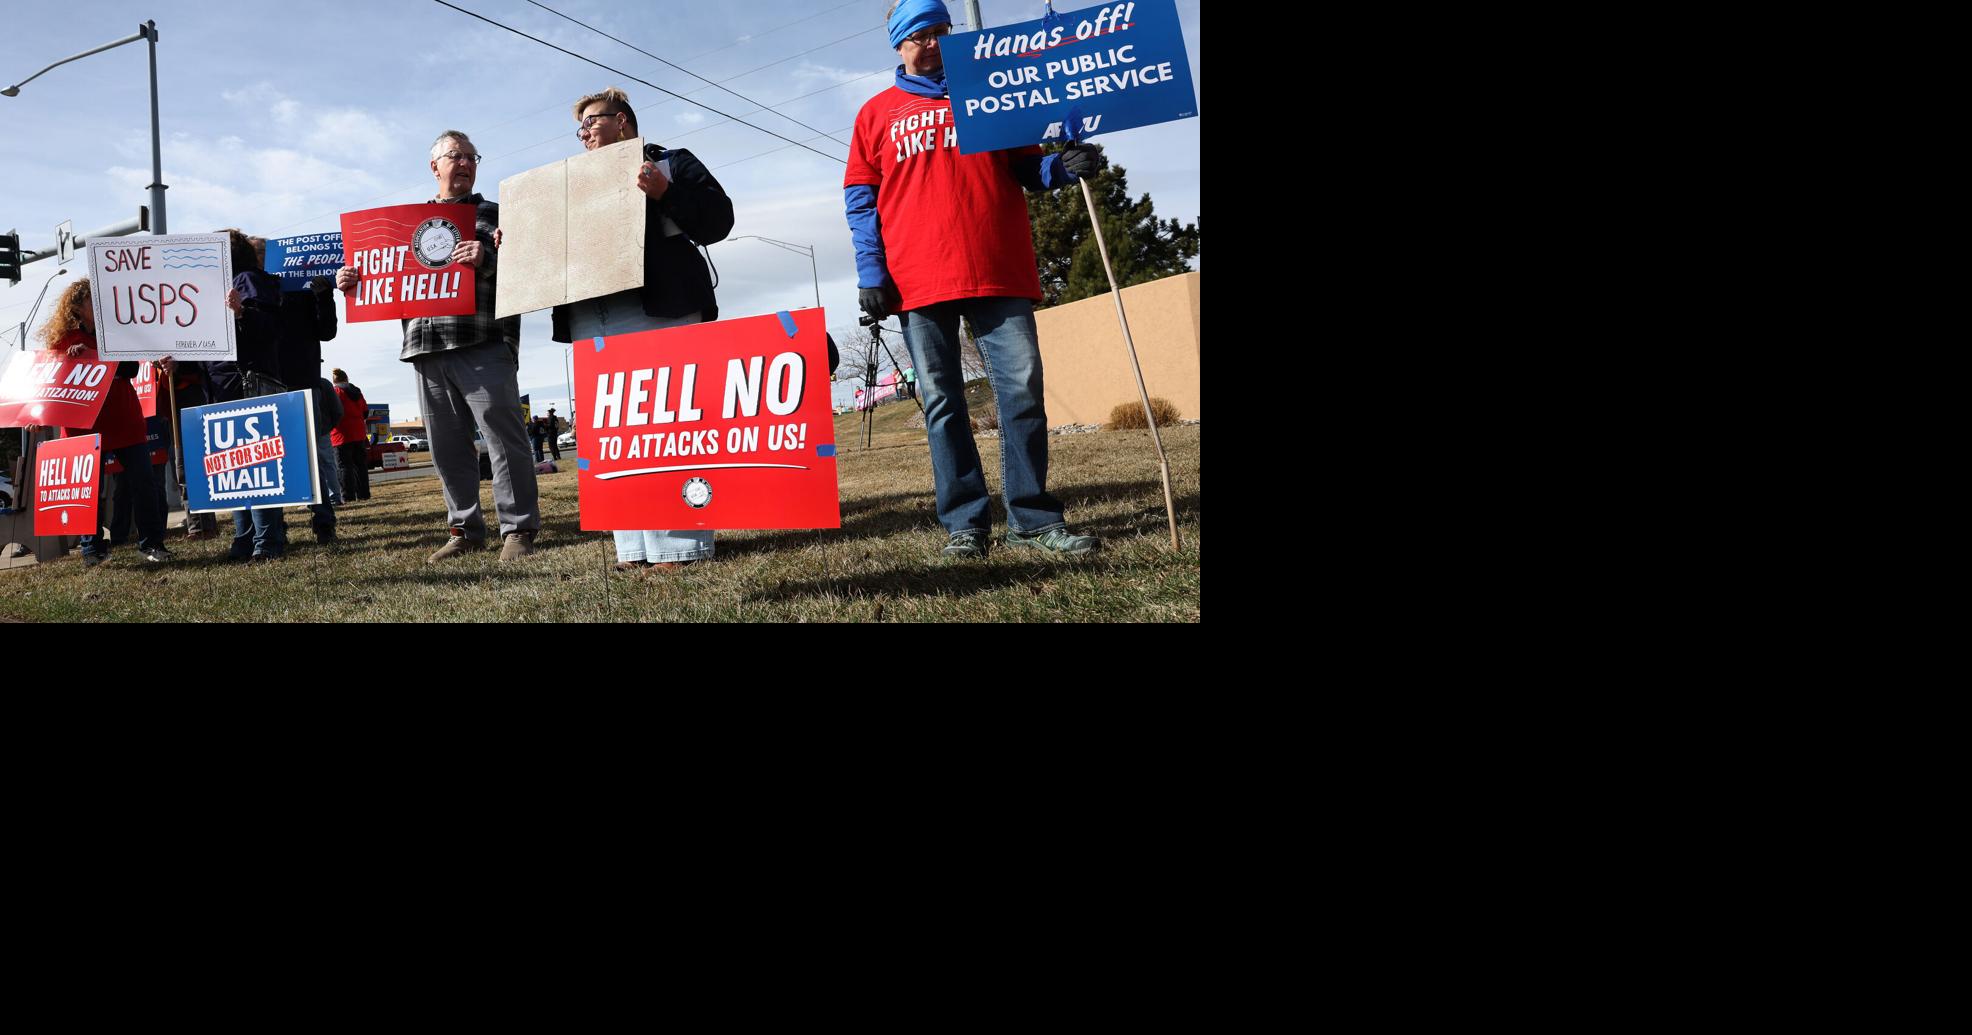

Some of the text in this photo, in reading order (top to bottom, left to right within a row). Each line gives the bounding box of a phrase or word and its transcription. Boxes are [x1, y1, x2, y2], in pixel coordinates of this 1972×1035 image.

[1075, 2, 1135, 41] off!
[988, 45, 1136, 89] OUR PUBLIC
[965, 62, 1173, 116] POSTAL SERVICE
[891, 108, 949, 142] FIGHT
[896, 128, 936, 163] LIKE
[286, 243, 330, 254] BELONGS
[296, 235, 321, 244] POST
[105, 246, 152, 273] SAVE
[283, 256, 304, 267] THE
[288, 270, 305, 278] THE
[306, 268, 338, 277] BILLION
[353, 245, 409, 276] FIGHT
[112, 283, 199, 327] USPS
[355, 271, 461, 306] LIKE HELL!
[63, 363, 107, 387] NO
[592, 351, 806, 430] HELL NO
[36, 387, 99, 401] ATIZATION!
[213, 416, 269, 450] U.S.
[599, 422, 807, 461] TO ATTACKS ON US!
[39, 453, 94, 487] HELL NO
[205, 439, 282, 473] NOT FOR SALE
[40, 486, 92, 502] TO ATTACKS ON US!
[217, 466, 274, 491] MAIL
